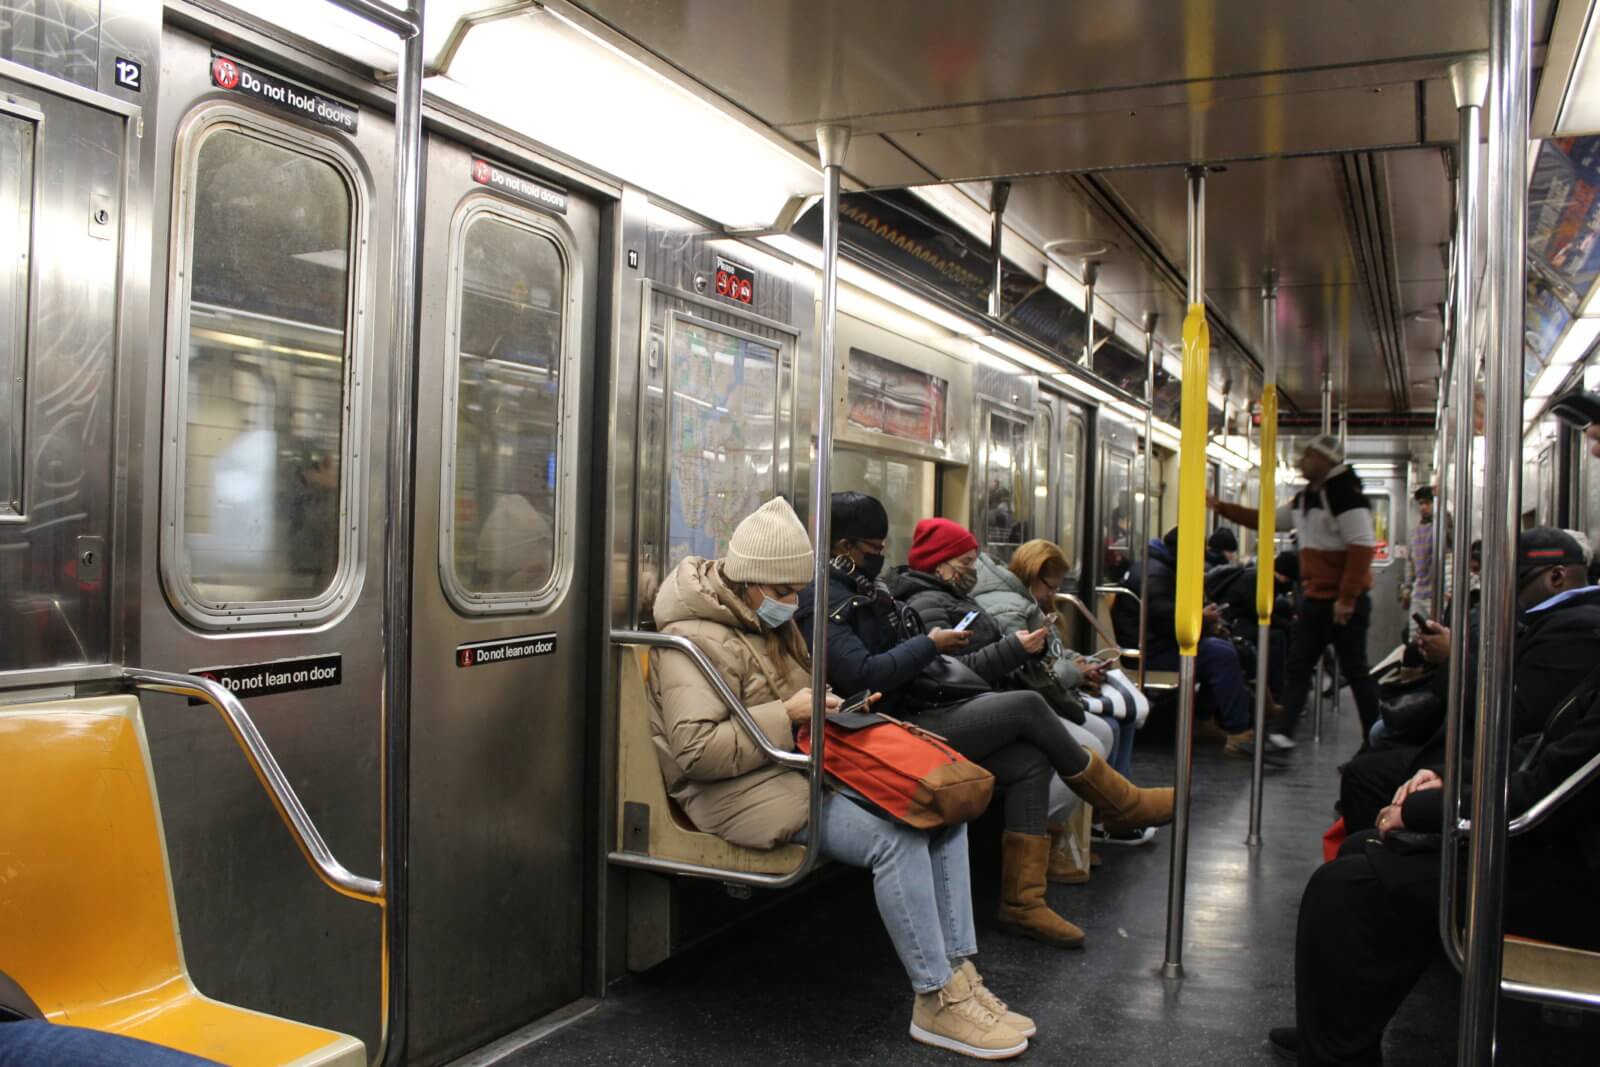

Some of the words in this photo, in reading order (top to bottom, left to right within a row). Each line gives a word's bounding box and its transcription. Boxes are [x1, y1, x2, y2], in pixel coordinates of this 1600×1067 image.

[116, 61, 139, 87] 12
[241, 72, 260, 93] Do
[264, 83, 285, 102] not
[288, 92, 315, 113] hold
[317, 100, 352, 126] doors
[491, 168, 502, 184] Do
[505, 177, 520, 190] not
[629, 252, 637, 267] 11
[476, 649, 490, 662] Do
[490, 647, 505, 660] not
[505, 645, 523, 658] lean
[523, 645, 534, 655] on
[535, 641, 553, 653] door
[221, 677, 240, 692] Do
[241, 674, 263, 690] not
[265, 671, 292, 687] lean
[293, 669, 309, 683] on
[309, 666, 337, 680] door
